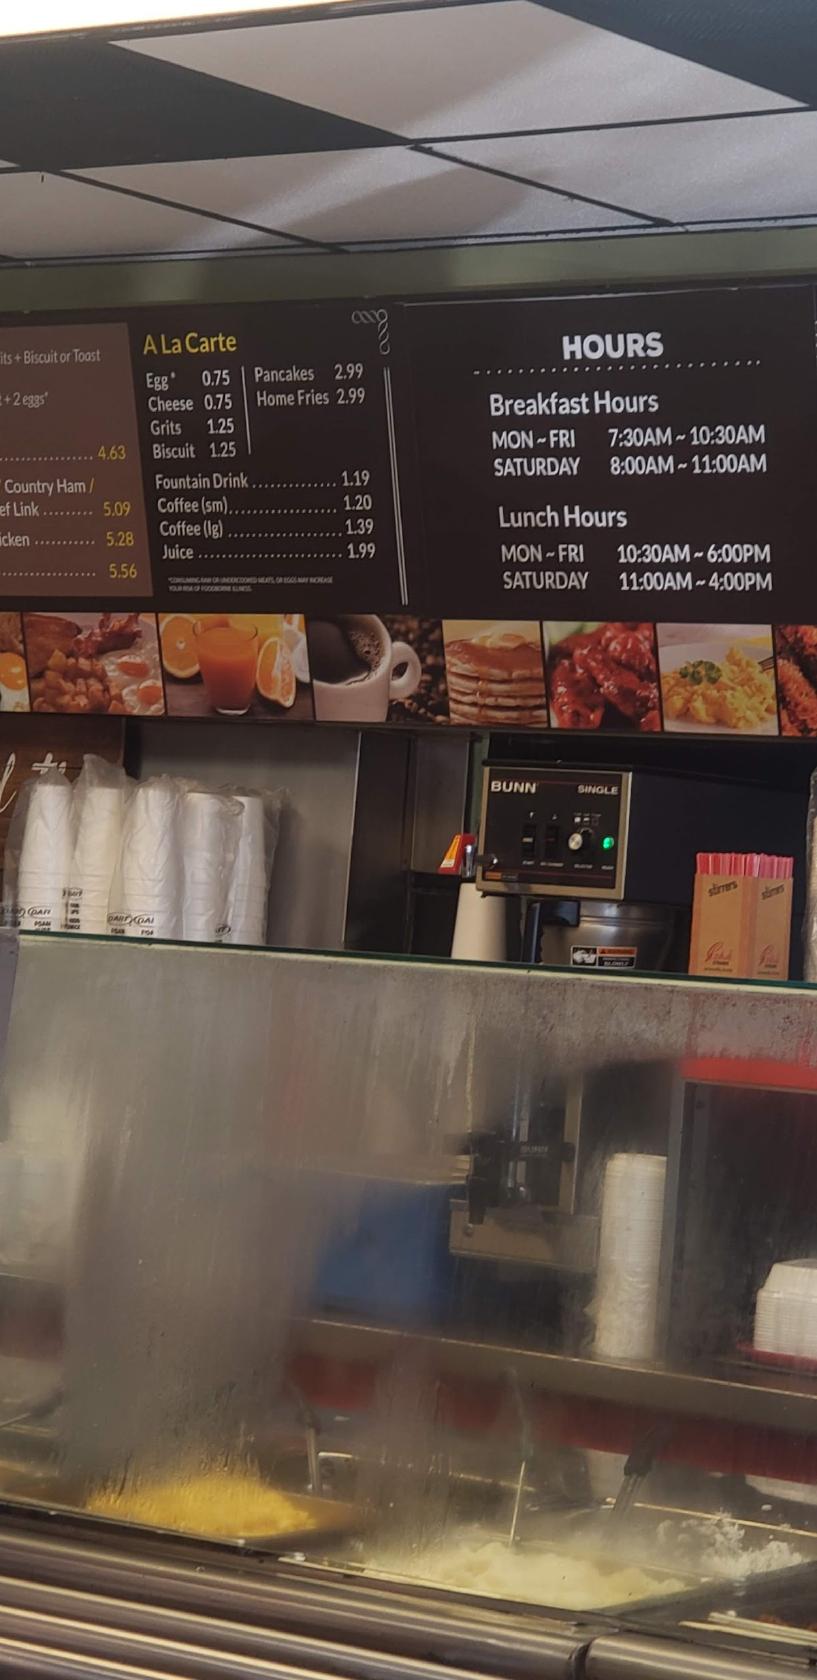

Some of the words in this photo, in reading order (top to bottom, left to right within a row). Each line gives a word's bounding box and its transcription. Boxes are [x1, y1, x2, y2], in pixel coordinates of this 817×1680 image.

[143, 334, 157, 354] A
[161, 334, 183, 354] La
[185, 332, 237, 353] Carte
[562, 331, 664, 360] HOURS
[24, 350, 58, 364] Biscuit
[60, 353, 71, 363] or
[73, 348, 101, 362] Toast
[202, 370, 230, 386] 0.75
[254, 366, 315, 384] Pancakes
[335, 363, 363, 380] 2.99
[13, 392, 21, 406] 2
[148, 395, 194, 411] Cheese
[204, 394, 232, 410] 0.75
[257, 390, 294, 407] Home
[298, 389, 330, 405] Fries
[336, 387, 366, 404] 2.99
[489, 392, 590, 416] Breakfast
[594, 390, 659, 414] Hours
[150, 420, 182, 435] Grits
[207, 418, 235, 434] 1.25
[492, 430, 534, 449] MON
[550, 429, 576, 448] FRI
[608, 427, 673, 447] 7:30AM
[690, 424, 766, 445] 10:30AM
[98, 445, 126, 460] 4.63
[153, 443, 196, 459] Biscuit
[209, 442, 237, 458] 1.25
[493, 457, 580, 476] SATURDAY
[610, 455, 675, 475] 8:00AM
[692, 454, 768, 473] 11:00AM
[155, 474, 210, 490] Fountain
[212, 472, 249, 489] Drink
[342, 470, 371, 486] 1.19
[5, 479, 54, 496] Country
[57, 478, 86, 494] Ham
[13, 501, 40, 517] Link
[103, 501, 131, 517] 5.09
[157, 498, 199, 514] Coffee
[201, 496, 228, 515] (sm)
[343, 495, 373, 511] 1.20
[498, 505, 560, 528] Lunch
[563, 505, 628, 528] Hours
[159, 521, 201, 537] Coffee
[203, 520, 224, 538] (lg)
[345, 519, 374, 535] 1.39
[106, 531, 135, 547] 5.28
[162, 544, 194, 560] Juice
[347, 543, 376, 559] 1.99
[501, 544, 543, 563] MON
[558, 544, 584, 563] FRI
[617, 544, 691, 564] 10:30AM
[707, 544, 771, 564] 6:00PM
[108, 563, 138, 579] 5.56
[503, 571, 589, 590] SATURDAY
[619, 572, 693, 592] 11:00AM
[708, 573, 773, 592] 4:00PM
[491, 780, 536, 794] BUNN
[577, 785, 619, 796] SINGLE
